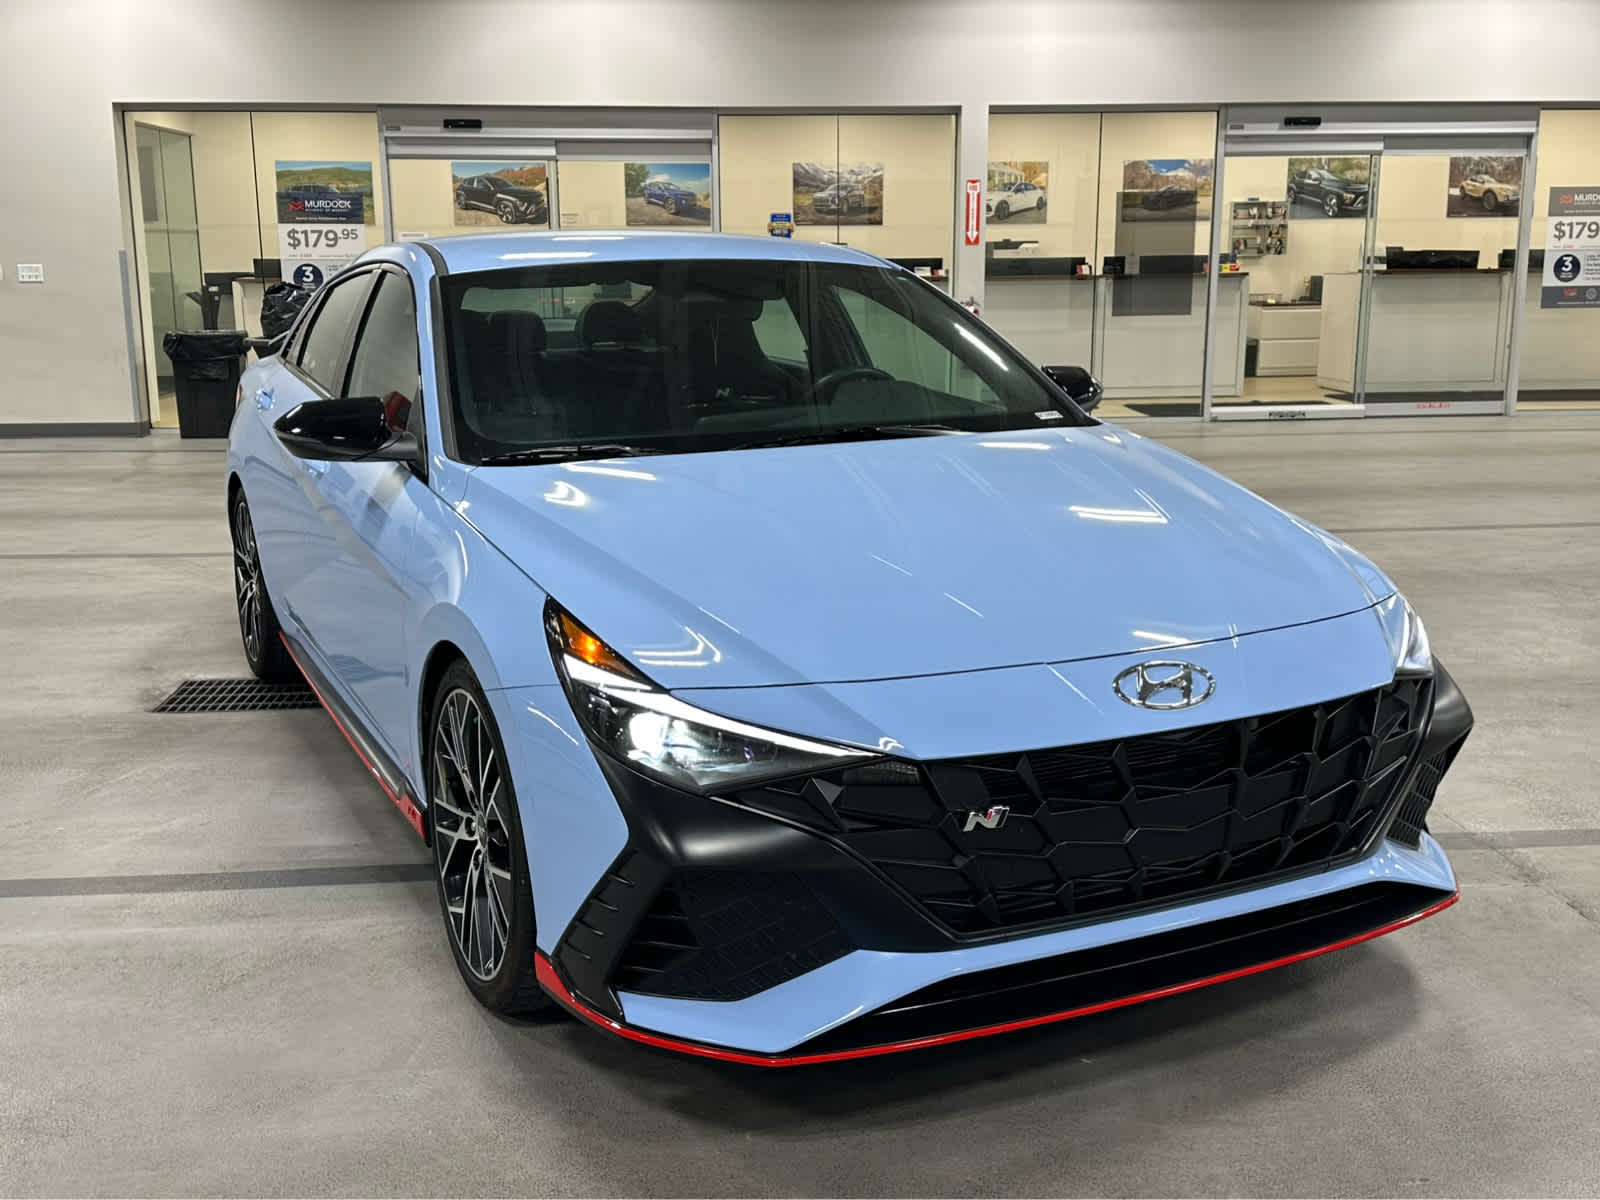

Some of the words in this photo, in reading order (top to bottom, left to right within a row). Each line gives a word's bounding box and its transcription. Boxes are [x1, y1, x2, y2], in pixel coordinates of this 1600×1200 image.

[304, 200, 351, 208] MURDOCK
[287, 228, 358, 249] $179.95
[1561, 257, 1573, 271] 3
[302, 266, 314, 281] 3
[963, 805, 1010, 832] N
